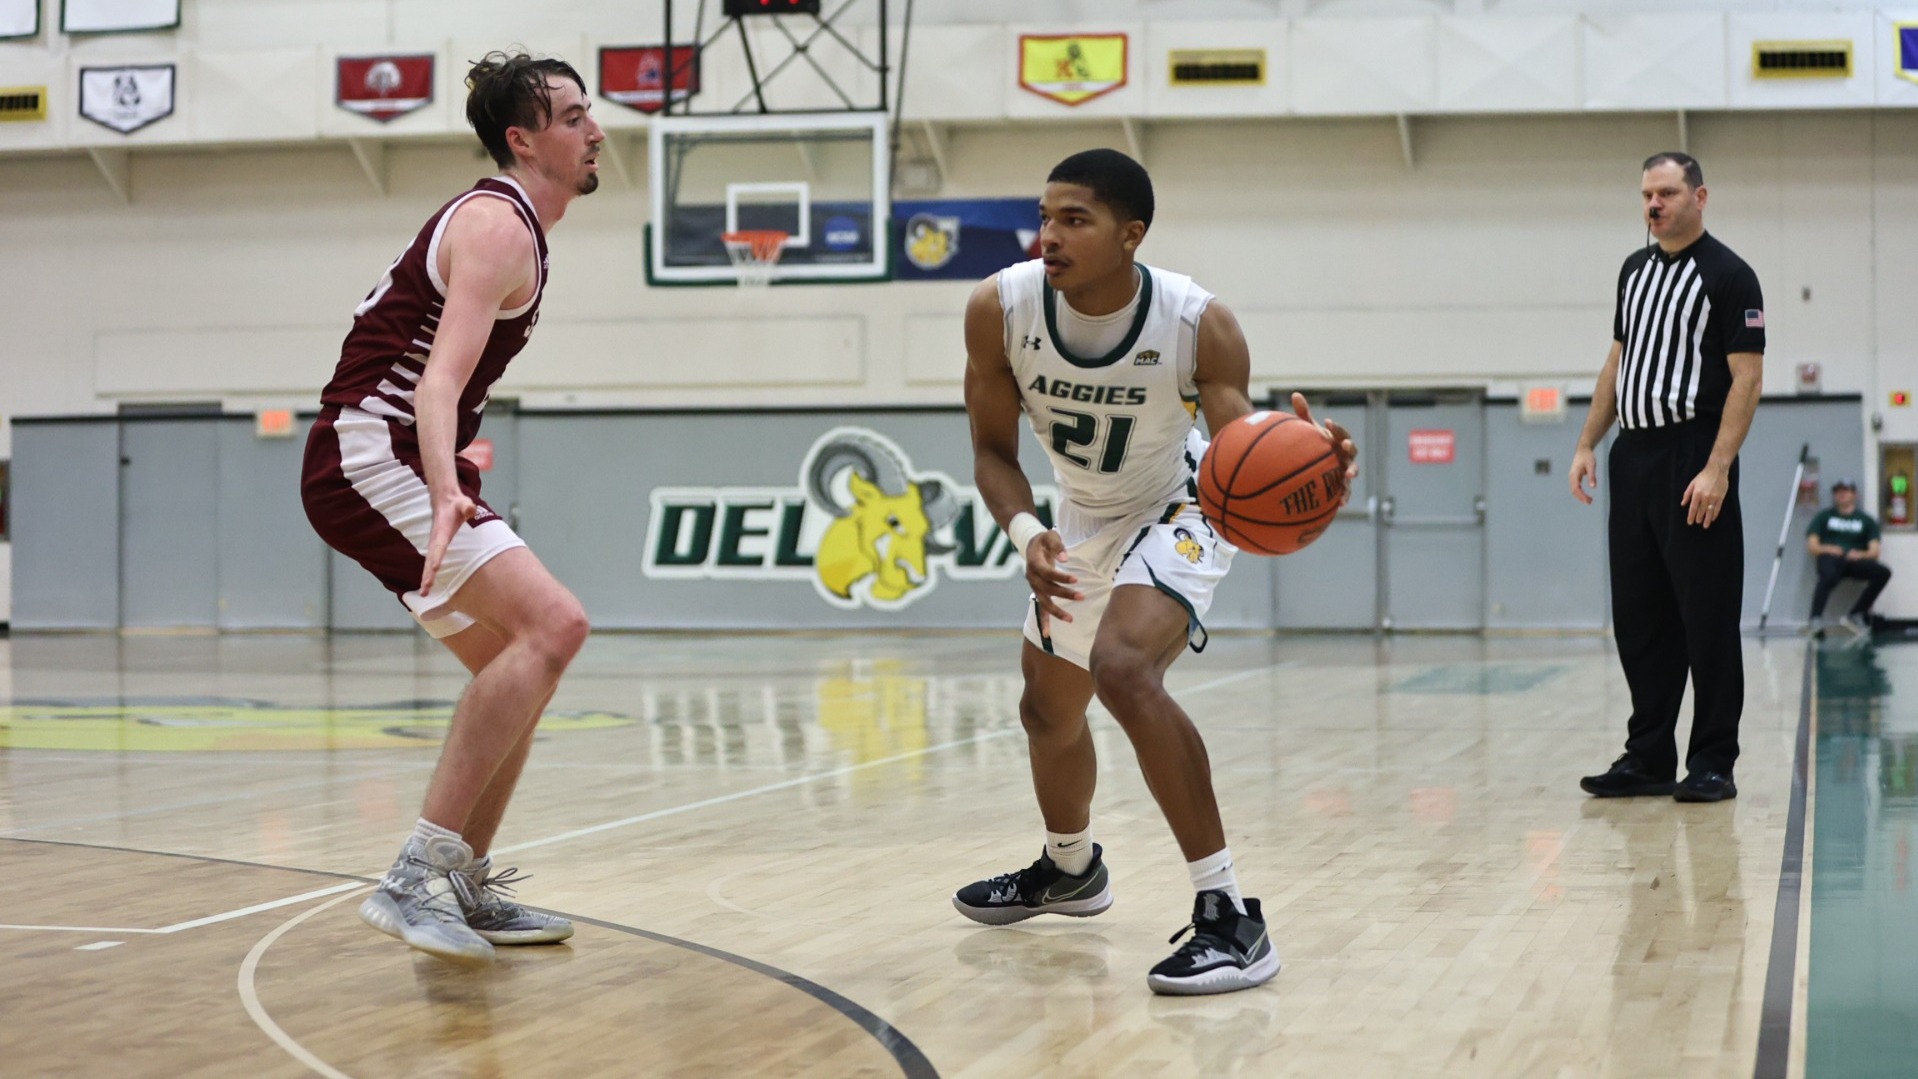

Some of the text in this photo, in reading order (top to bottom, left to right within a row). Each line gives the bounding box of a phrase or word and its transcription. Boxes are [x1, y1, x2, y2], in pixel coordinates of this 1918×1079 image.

[1135, 356, 1158, 366] MAC
[1028, 375, 1147, 405] AGGIES
[1047, 406, 1137, 475] 21
[1280, 479, 1320, 516] THE
[655, 500, 816, 566] DEL
